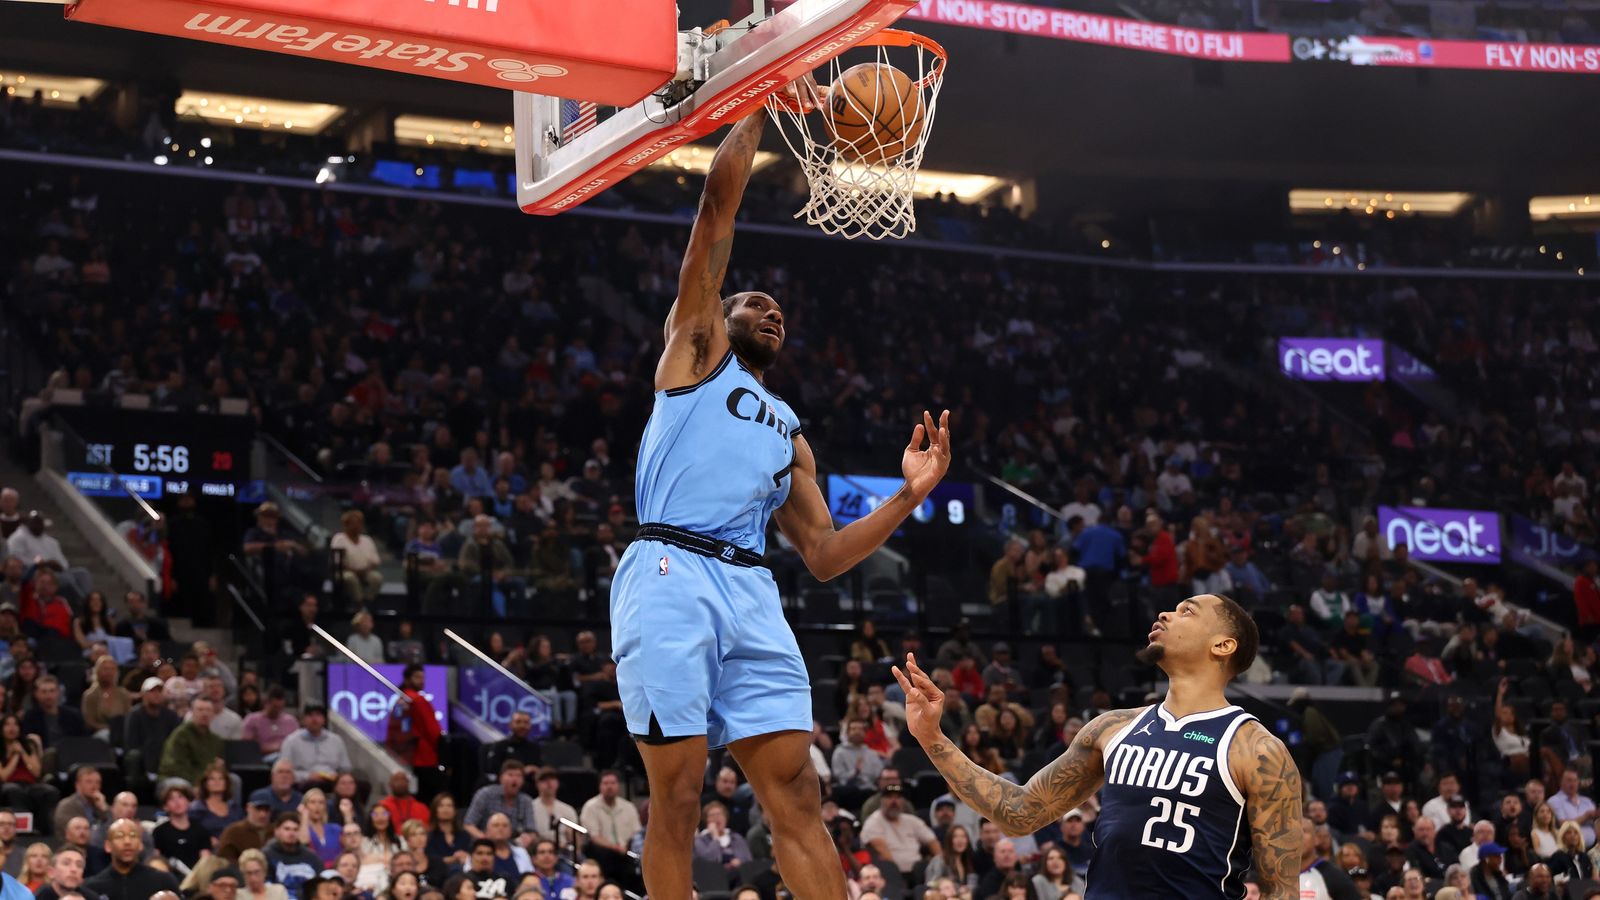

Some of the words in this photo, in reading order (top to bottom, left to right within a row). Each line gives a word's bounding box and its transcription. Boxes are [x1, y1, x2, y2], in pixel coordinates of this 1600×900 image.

[802, 42, 843, 64] HERDEZ
[840, 21, 879, 42] SALSA
[936, 0, 1048, 32] NON-STOP
[1052, 14, 1110, 42] FROM
[1113, 20, 1169, 50] HERE
[1171, 27, 1200, 54] TO
[1203, 33, 1244, 58] FIJI
[1486, 44, 1525, 67] FLY
[1530, 46, 1600, 71] NON-S
[707, 98, 746, 121] HERDEZ
[742, 79, 779, 98] SALSA
[624, 147, 658, 166] HERDEZ
[654, 134, 689, 149] SALSA
[550, 193, 581, 210] HERDEZ
[579, 178, 609, 194] SALSA
[1284, 344, 1381, 375] neat.
[134, 444, 189, 473] 5:56
[948, 499, 965, 525] 9
[1387, 515, 1495, 556] neat.
[1183, 731, 1215, 744] chime
[1108, 743, 1215, 797] MAVS
[1141, 796, 1201, 854] 25
